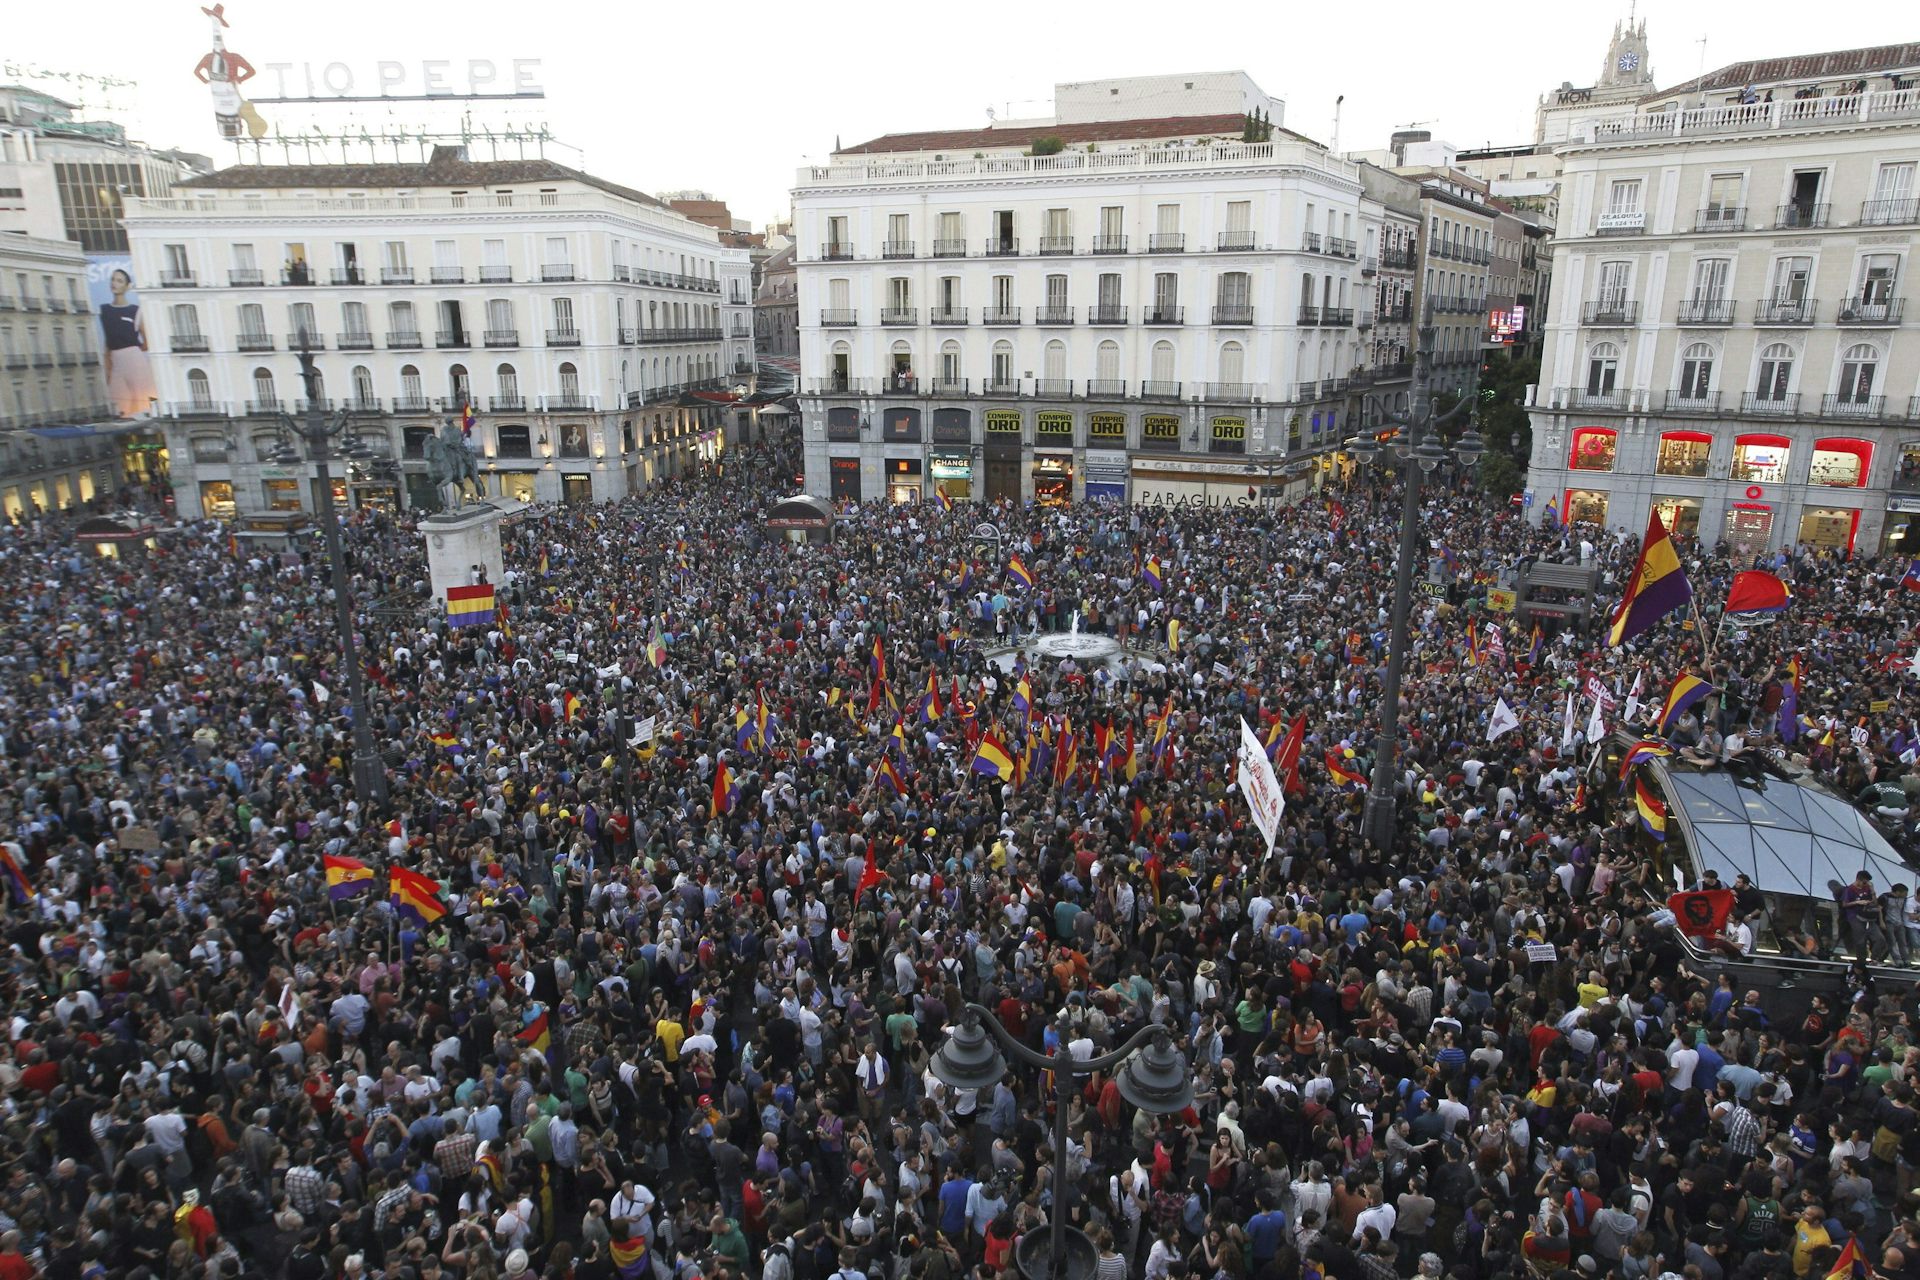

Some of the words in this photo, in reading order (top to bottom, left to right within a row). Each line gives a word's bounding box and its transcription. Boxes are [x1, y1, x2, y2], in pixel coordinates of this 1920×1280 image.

[265, 61, 354, 97] TIO
[376, 58, 544, 96] PEPE
[987, 420, 1020, 431] ORO
[1038, 421, 1072, 432] ORO
[1145, 417, 1179, 425] COMPRO
[1213, 418, 1245, 426] COMPRO
[1091, 423, 1124, 434] ORO
[1144, 425, 1178, 436] ORO
[1212, 426, 1245, 438] ORO
[832, 459, 859, 470] Orange
[935, 459, 969, 467] CHANGE
[1154, 461, 1183, 472] CASA
[1190, 463, 1205, 472] DE
[1142, 491, 1247, 508] PARAGUAS
[955, 936, 961, 945] 5
